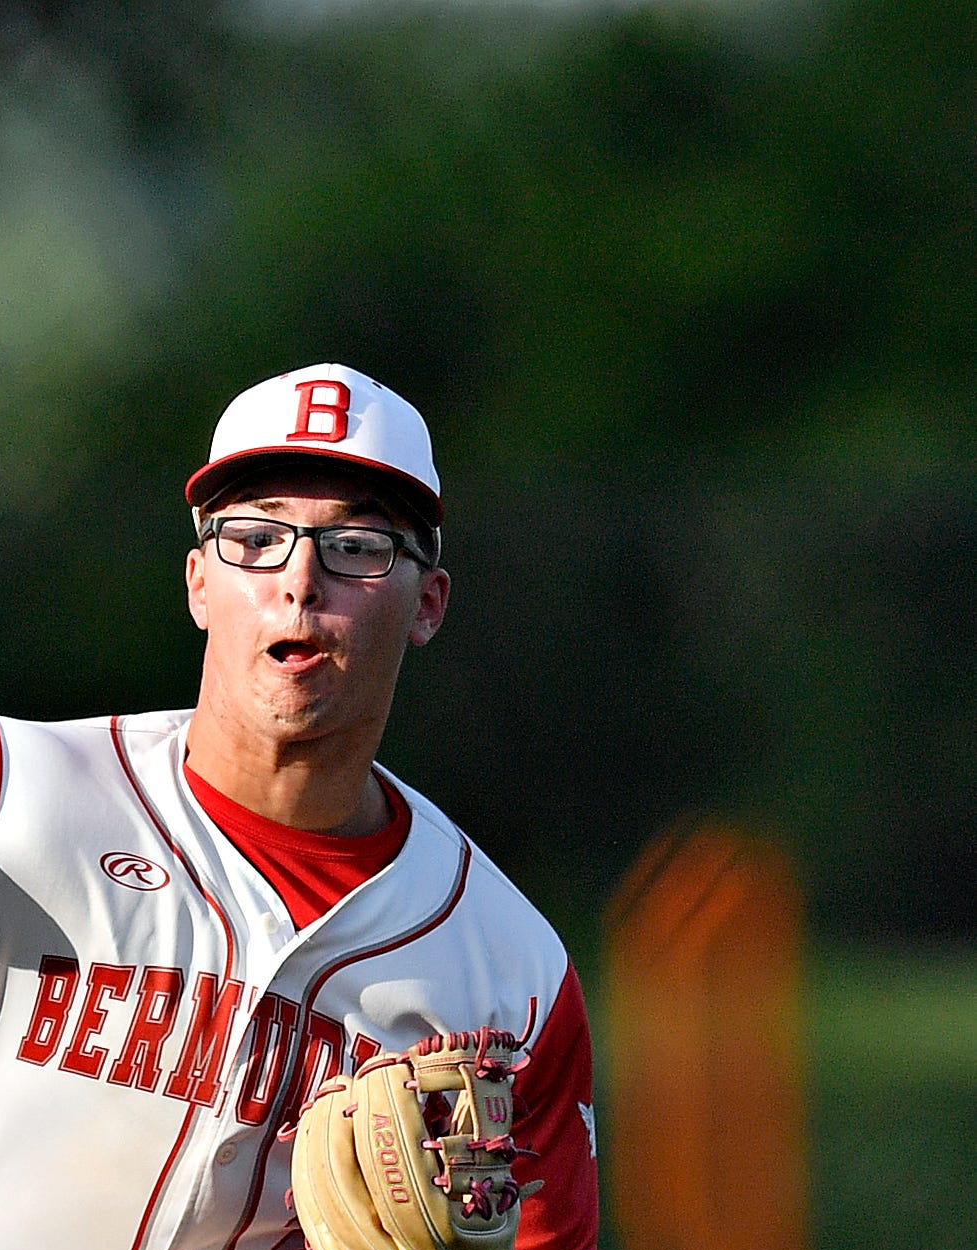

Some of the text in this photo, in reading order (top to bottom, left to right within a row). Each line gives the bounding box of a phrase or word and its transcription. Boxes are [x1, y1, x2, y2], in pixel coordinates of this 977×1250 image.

[286, 379, 351, 443] B
[16, 954, 383, 1128] BERMUD
[372, 1112, 410, 1204] A2000
